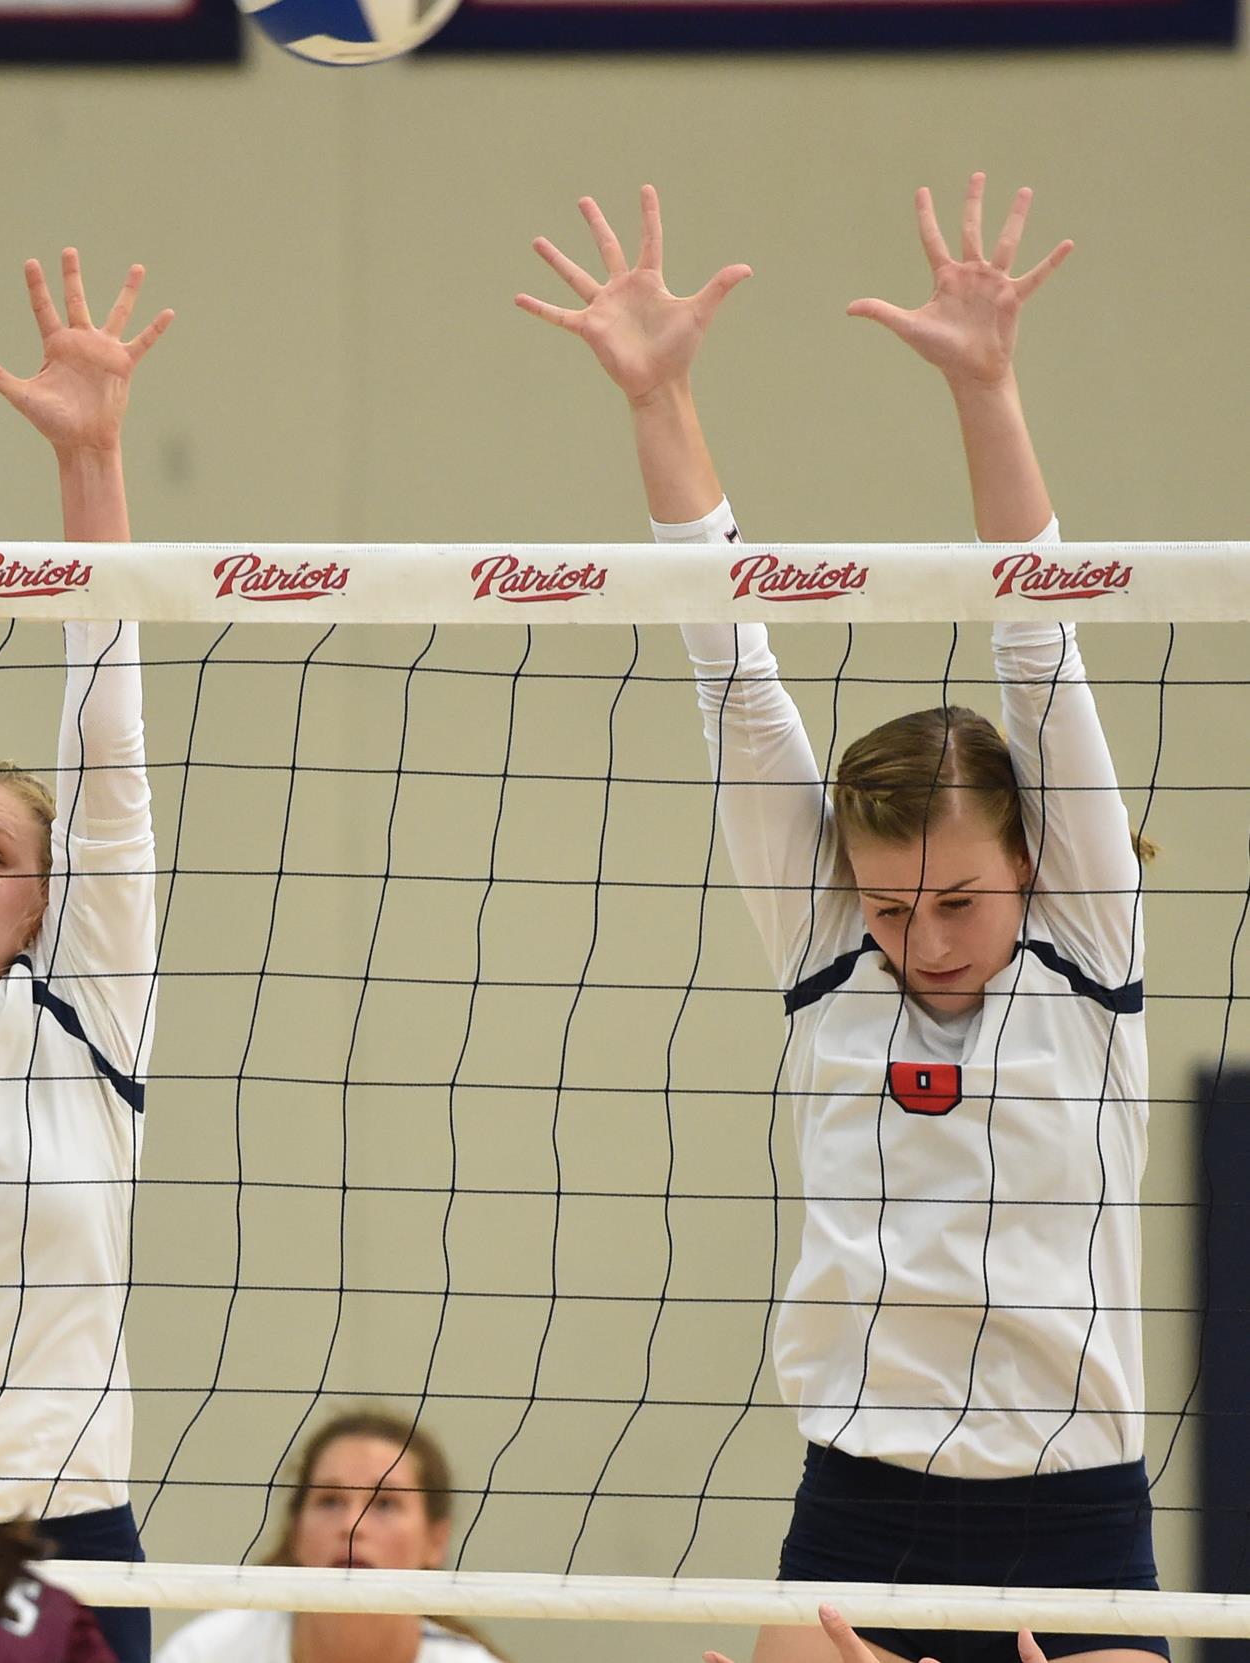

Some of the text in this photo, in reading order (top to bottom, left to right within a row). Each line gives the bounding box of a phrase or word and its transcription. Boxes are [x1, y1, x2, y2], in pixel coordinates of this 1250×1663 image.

[214, 554, 349, 601] Patriots
[471, 556, 607, 602] Patriots
[730, 554, 869, 601] Patriots
[992, 553, 1133, 600] Patriots
